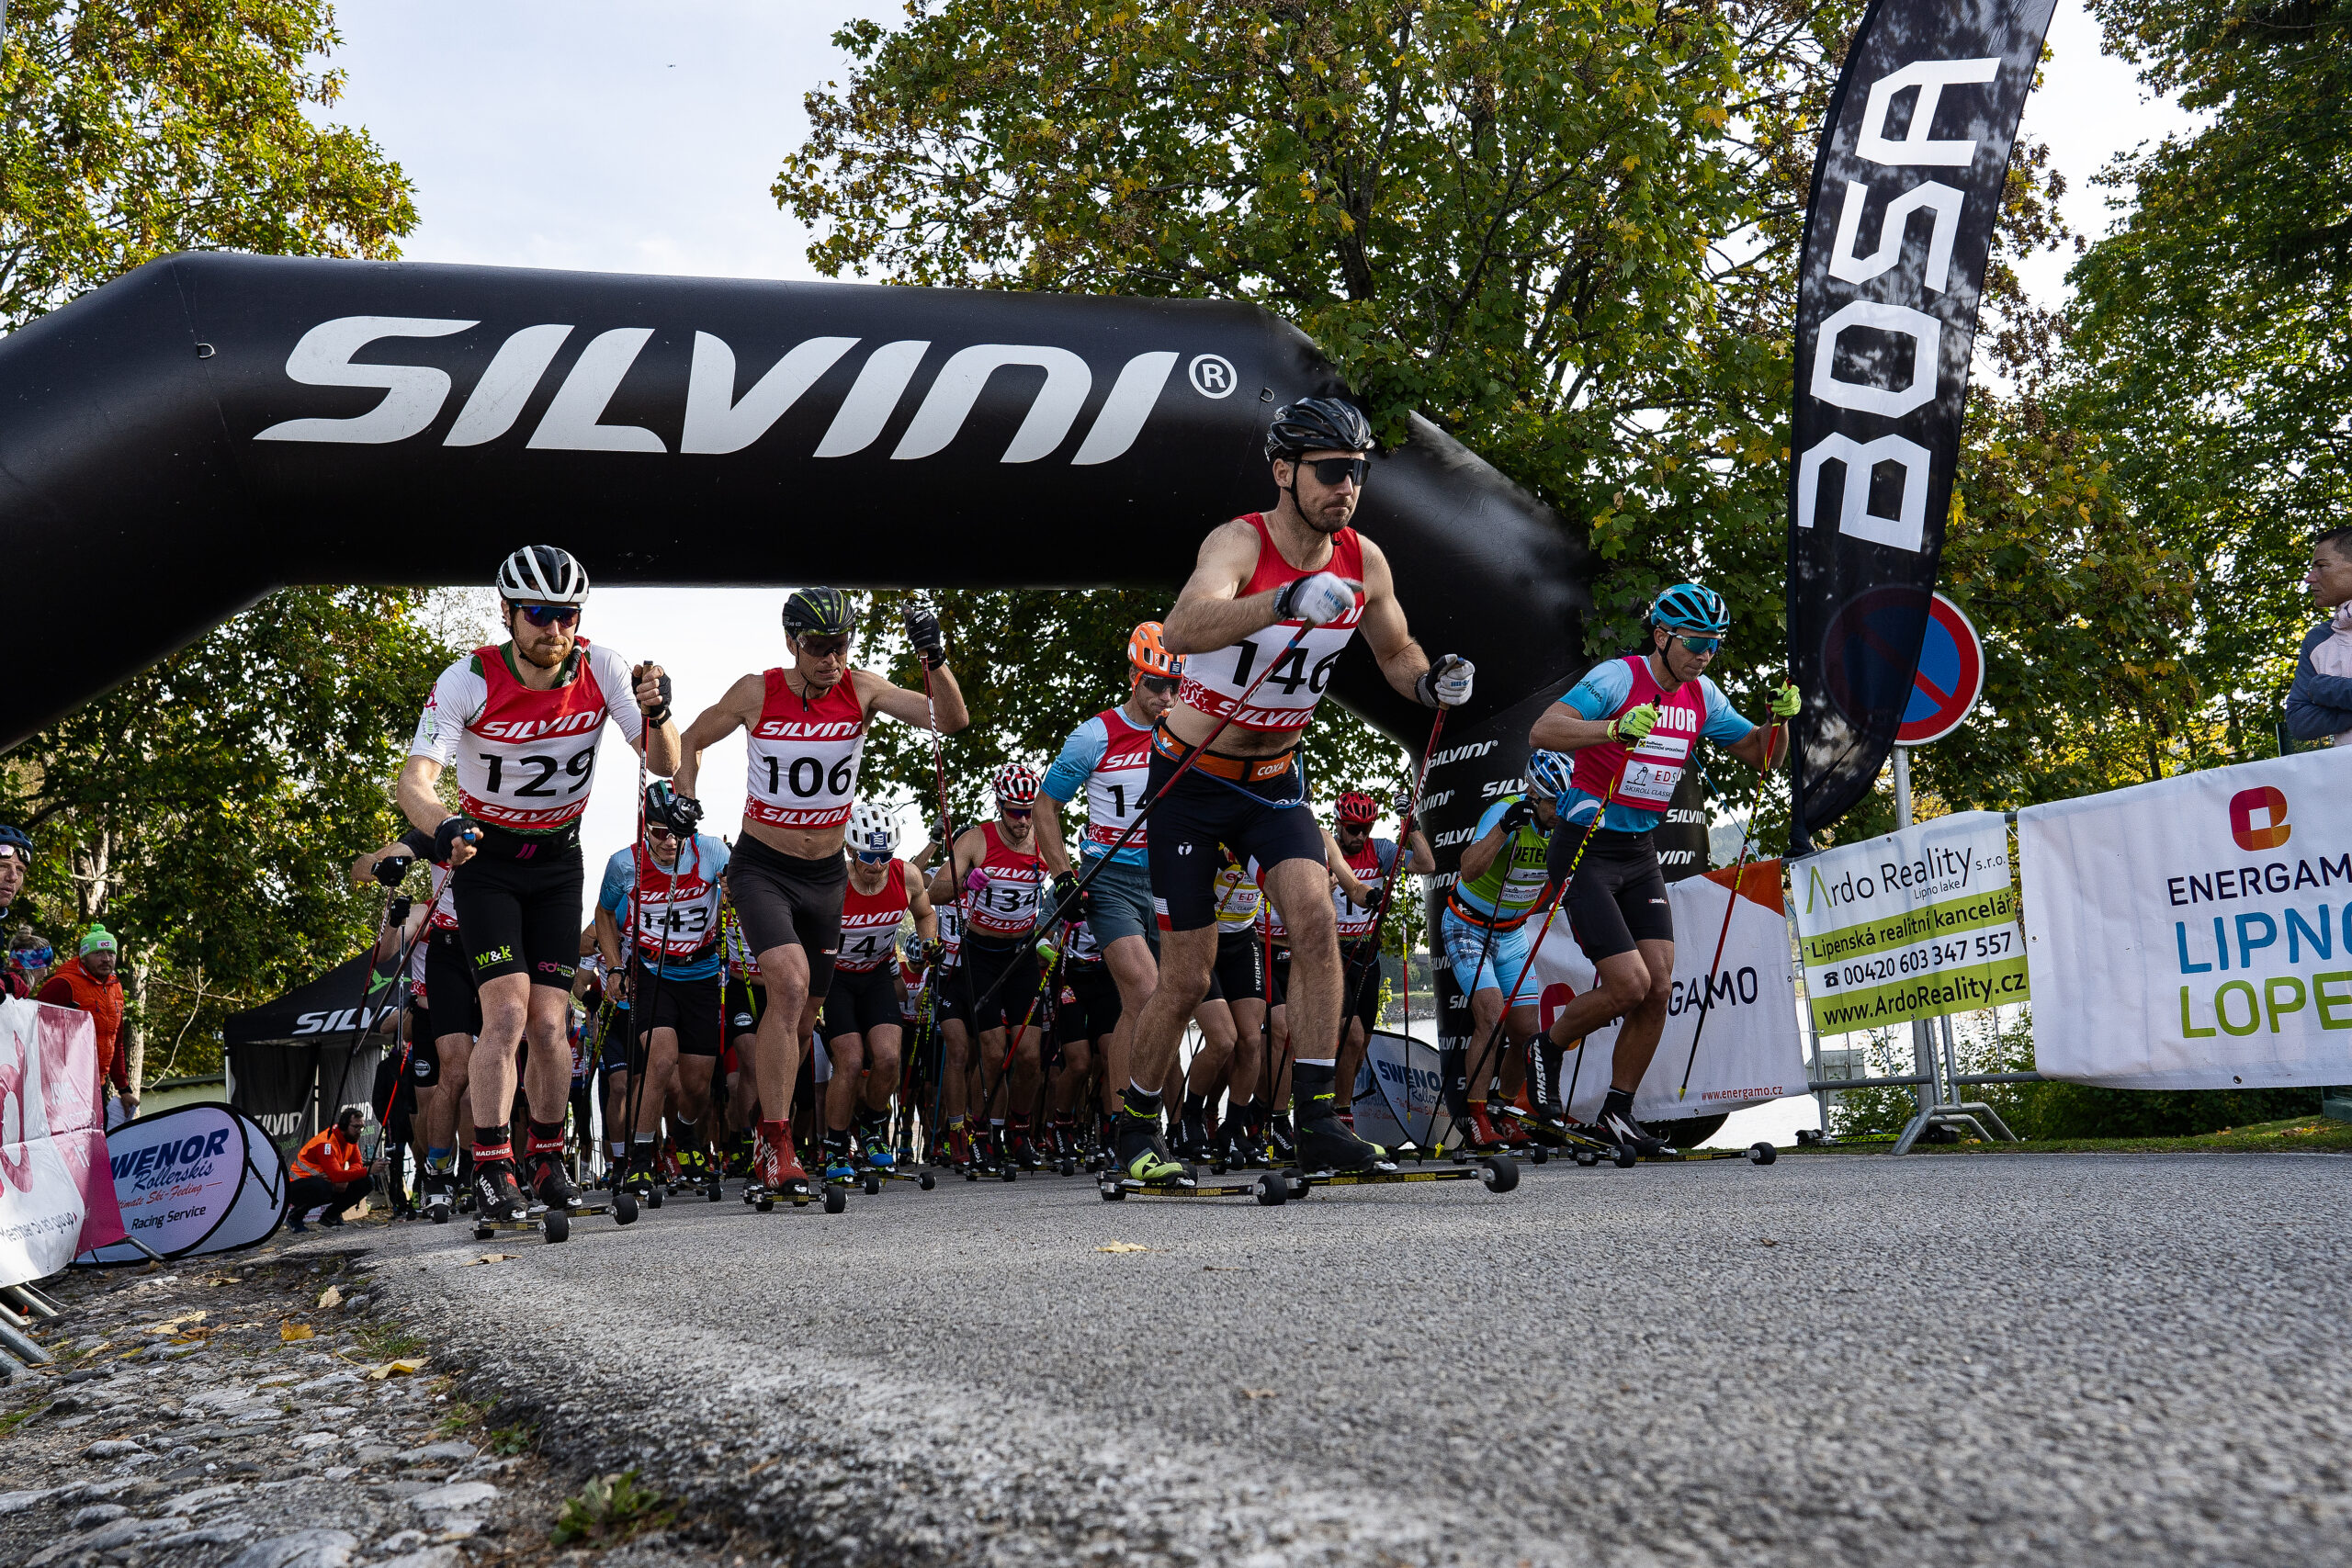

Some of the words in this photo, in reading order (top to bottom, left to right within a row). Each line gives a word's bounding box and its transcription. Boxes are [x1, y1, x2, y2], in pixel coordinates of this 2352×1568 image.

[1798, 57, 2001, 553] BOSA
[1231, 639, 1342, 696] 146
[482, 708, 607, 739] SILVINI
[759, 721, 862, 738] SILVINI
[1641, 703, 1697, 733] NIOR
[480, 746, 595, 797] 129
[763, 754, 853, 798] 106
[1257, 761, 1285, 777] COXA
[1624, 784, 1650, 795] SKIROLL
[478, 796, 590, 823] SILVINI
[761, 802, 851, 825] SILVINI
[1514, 846, 1547, 863] VETE
[1657, 851, 1692, 865] VINI
[1880, 847, 1972, 894] Reality
[1975, 854, 2006, 871] s.r.o.
[985, 886, 1039, 913] 134
[1914, 884, 1939, 901] Lipno
[1939, 879, 1961, 894] lake
[1812, 926, 1877, 961] Lipenská
[1880, 913, 1931, 943] realitní
[1933, 891, 2013, 929] kancelář
[1843, 958, 1895, 986] 00420
[1899, 950, 1928, 974] 603
[1932, 940, 1968, 965] 347
[1976, 931, 2012, 957] 557
[1823, 973, 2027, 1026] www.ArdoReality.cz
[2179, 970, 2352, 1039] LOPE
[1377, 1059, 1442, 1092] SWENO
[1702, 1085, 1784, 1101] www.energamo.cz
[110, 1128, 230, 1180] WENOR
[476, 1147, 511, 1156] MADSHUS
[131, 1156, 215, 1194] Rollerskis
[131, 1214, 164, 1231] Racing
[166, 1204, 207, 1224] Service
